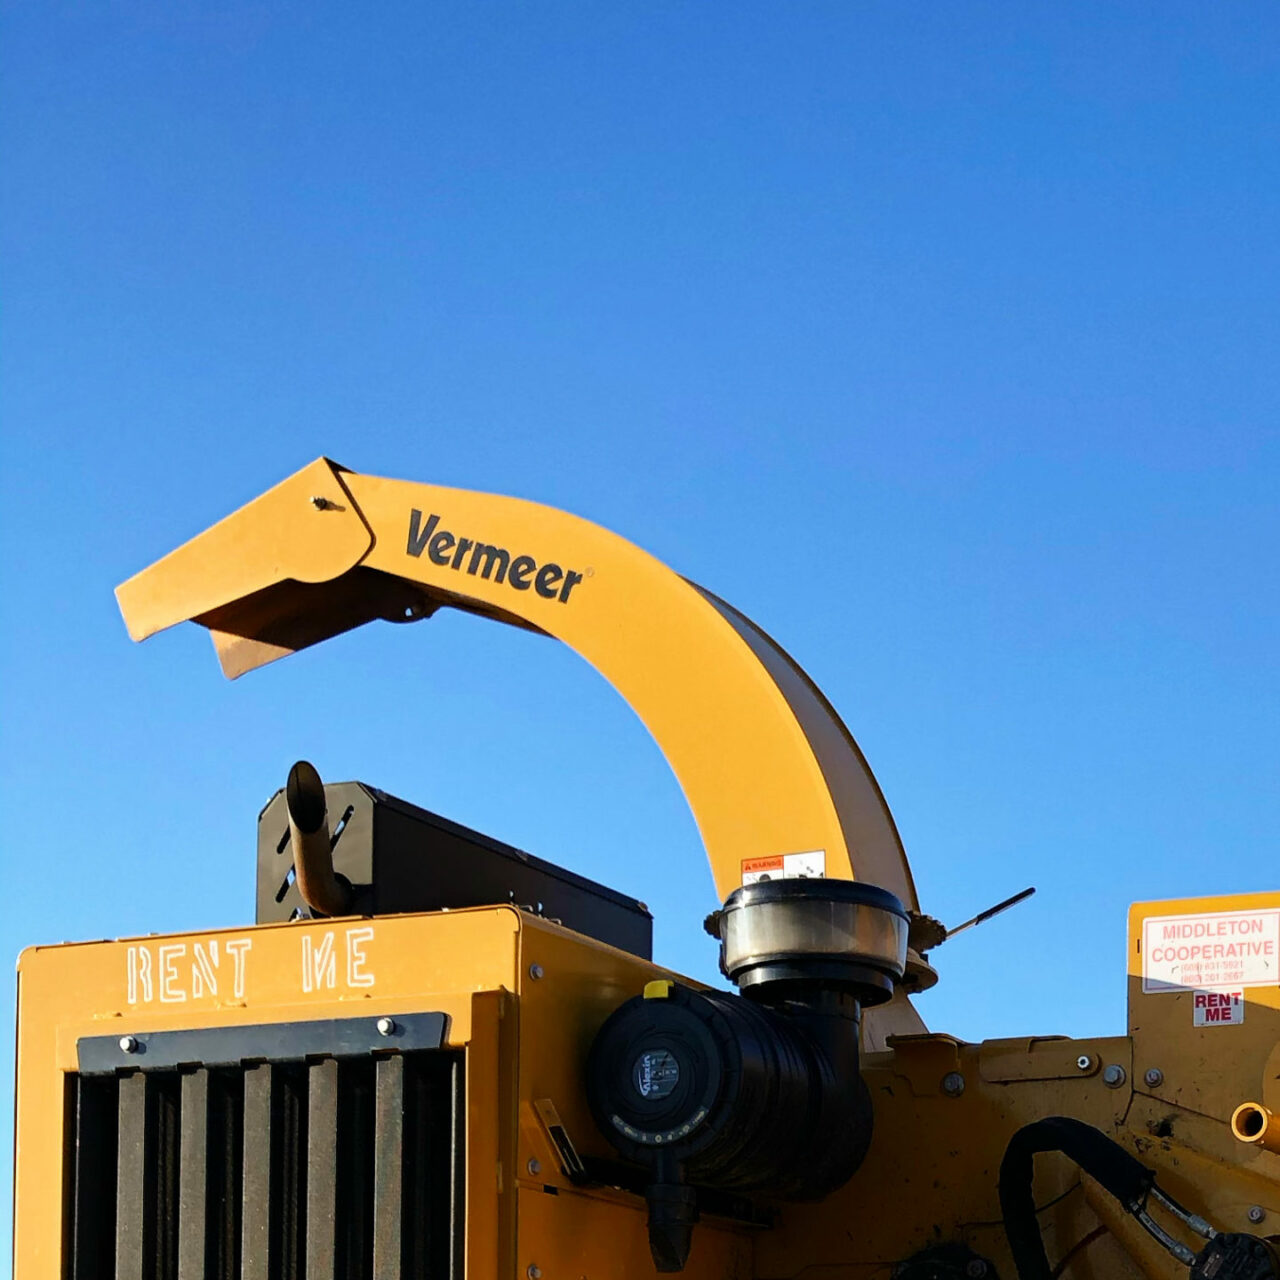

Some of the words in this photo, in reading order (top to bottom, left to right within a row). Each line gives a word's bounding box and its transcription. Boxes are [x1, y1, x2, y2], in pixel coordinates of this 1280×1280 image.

[406, 508, 583, 604] Vermeer
[1162, 919, 1264, 941] MIDDLETON
[1151, 940, 1275, 963] COOPERATIVE
[127, 938, 253, 1004] RENT
[301, 927, 375, 993] ME
[1194, 992, 1242, 1009] RENT
[1205, 1007, 1232, 1022] ME
